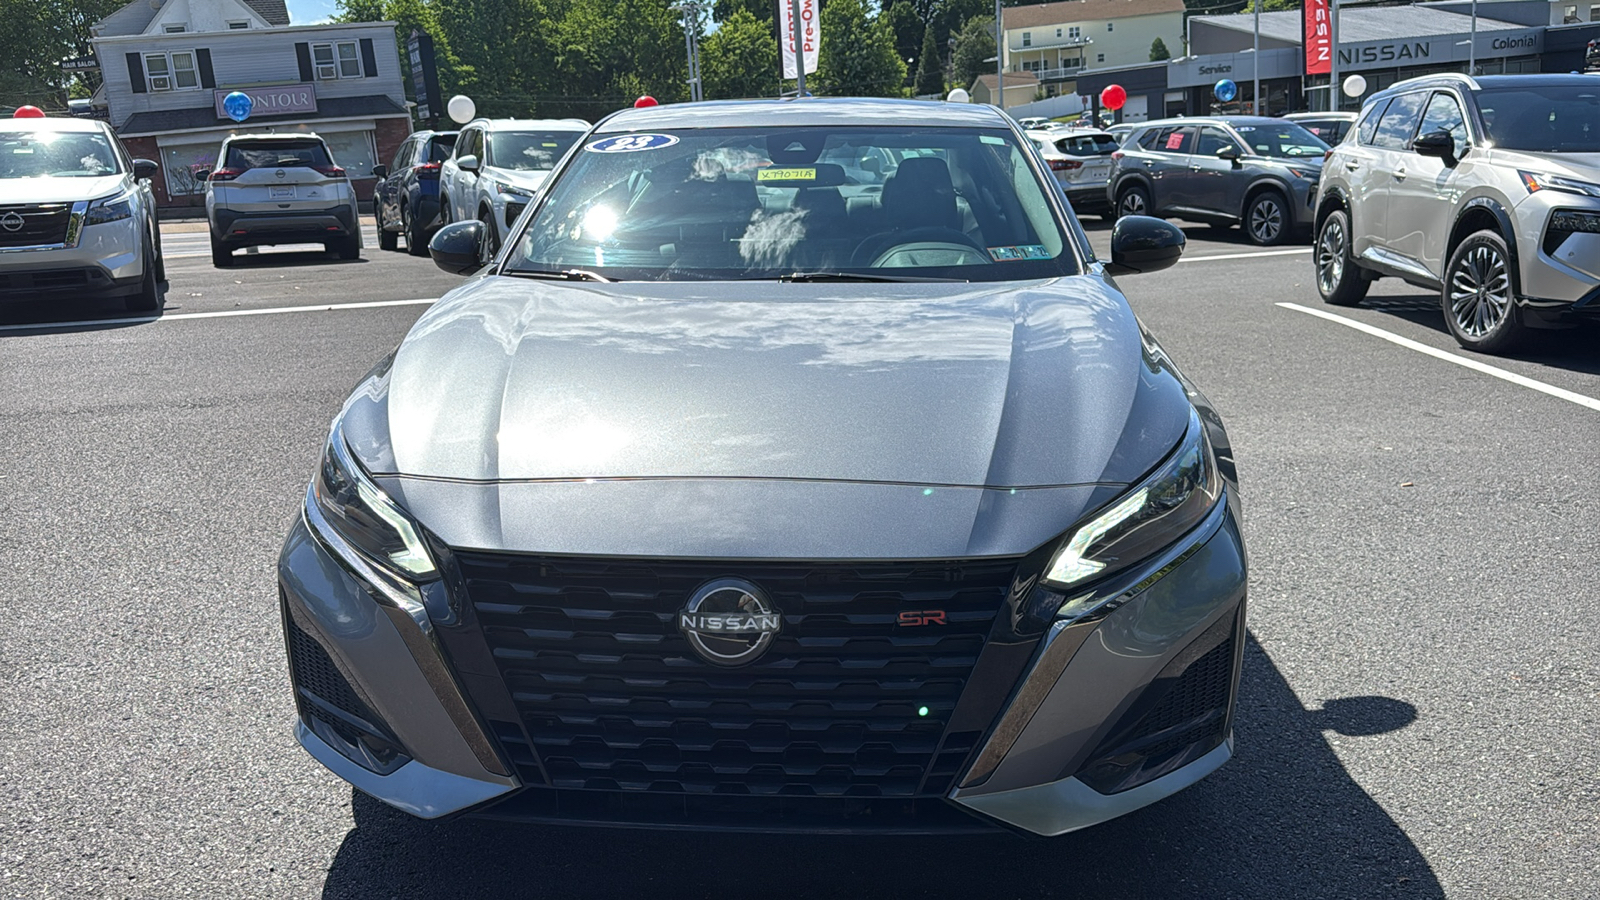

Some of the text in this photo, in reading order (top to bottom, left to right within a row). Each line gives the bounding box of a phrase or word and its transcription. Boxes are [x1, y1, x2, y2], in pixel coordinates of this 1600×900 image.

[1492, 34, 1537, 50] Colonial
[1338, 42, 1430, 65] NISSAN
[61, 61, 76, 69] HAIR
[1198, 63, 1232, 75] Service
[681, 614, 778, 631] NISSAN
[899, 610, 947, 626] SR
